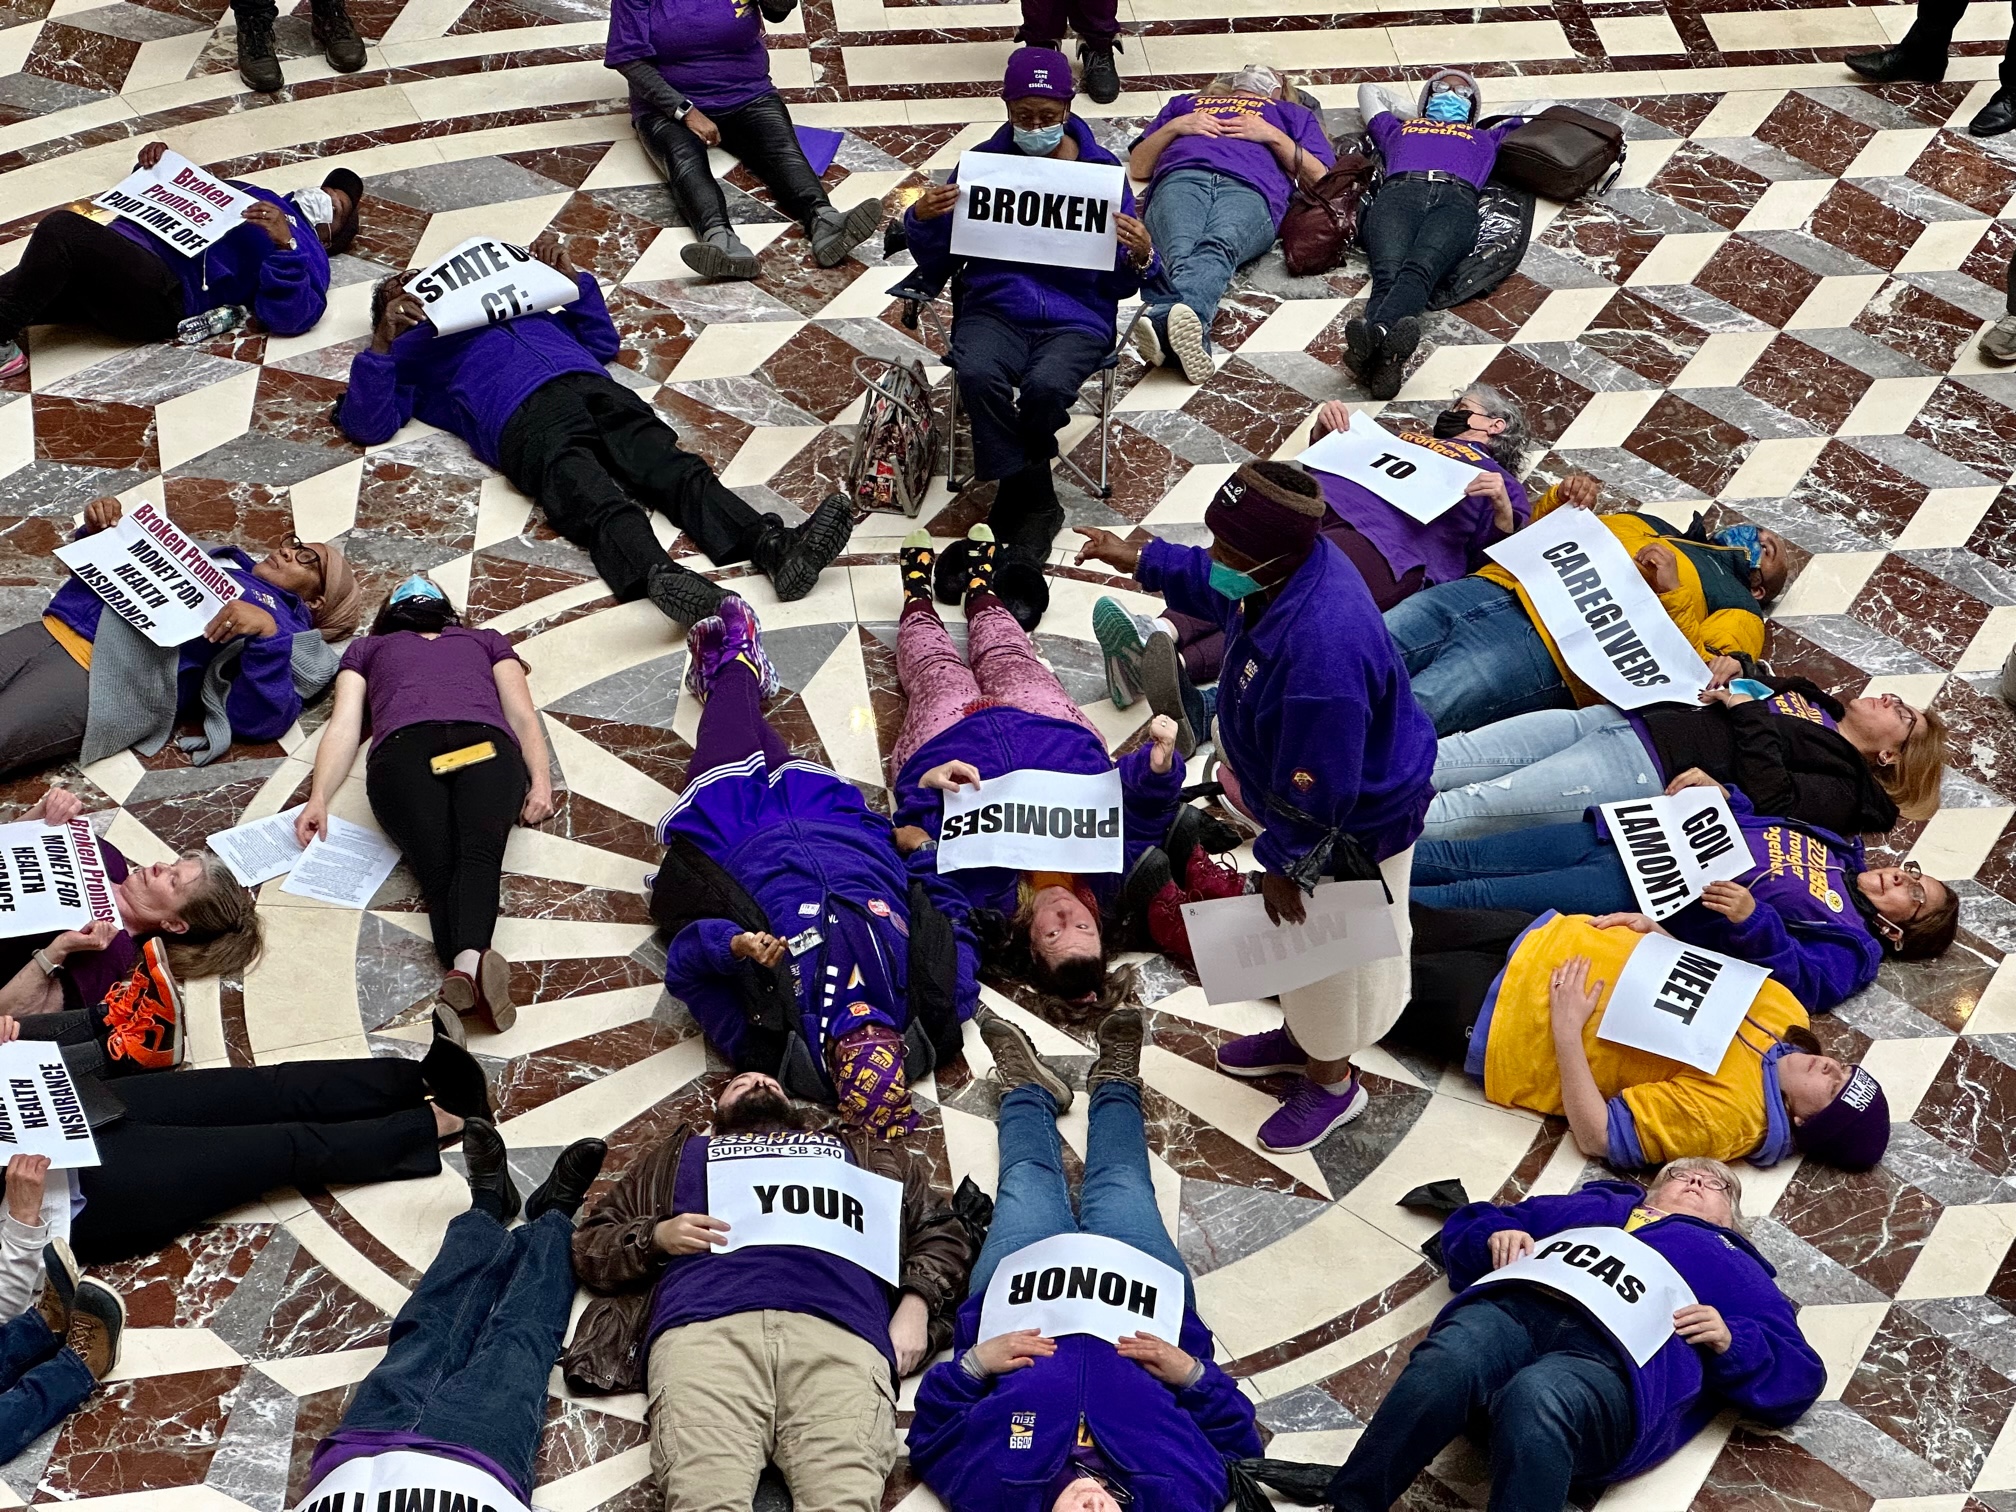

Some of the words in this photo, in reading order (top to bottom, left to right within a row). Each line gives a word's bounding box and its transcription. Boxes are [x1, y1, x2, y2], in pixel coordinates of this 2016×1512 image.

[1401, 126, 1474, 140] Together
[141, 183, 214, 227] Promise:
[172, 166, 235, 208] Broken
[967, 185, 1109, 234] BROKEN
[101, 191, 144, 213] PAID
[137, 205, 181, 234] TIME
[172, 228, 210, 251] OFF
[415, 242, 510, 303] STATE
[480, 283, 533, 324] CT:
[1369, 453, 1417, 479] TO
[133, 503, 188, 556] Broken
[75, 562, 157, 631] INSURANCE
[112, 563, 169, 609] HEALTH
[127, 539, 182, 582] MONEY
[170, 577, 204, 610] FOR
[1542, 541, 1671, 687] CAREGIVERS
[68, 819, 98, 866] Broken
[942, 803, 1119, 841] PROMISES
[1682, 806, 1734, 870] GOV.
[11, 847, 46, 894] HEALTH
[41, 835, 75, 879] MONEY
[1614, 804, 1690, 916] LAMONT:
[54, 880, 81, 908] FOR
[1653, 950, 1723, 1026] MEET
[861, 1071, 879, 1094] SEIU
[869, 1052, 891, 1069] SEIU
[9, 1079, 49, 1129] HEALTH
[39, 1063, 89, 1140] INSURANCE
[1842, 1081, 1862, 1102] ALL
[711, 1146, 784, 1158] SUPPORT
[788, 1146, 809, 1155] SB
[813, 1146, 842, 1159] 340
[753, 1185, 864, 1234] YOUR
[1008, 1267, 1157, 1319] HONOR
[1534, 1241, 1646, 1304] PCAS
